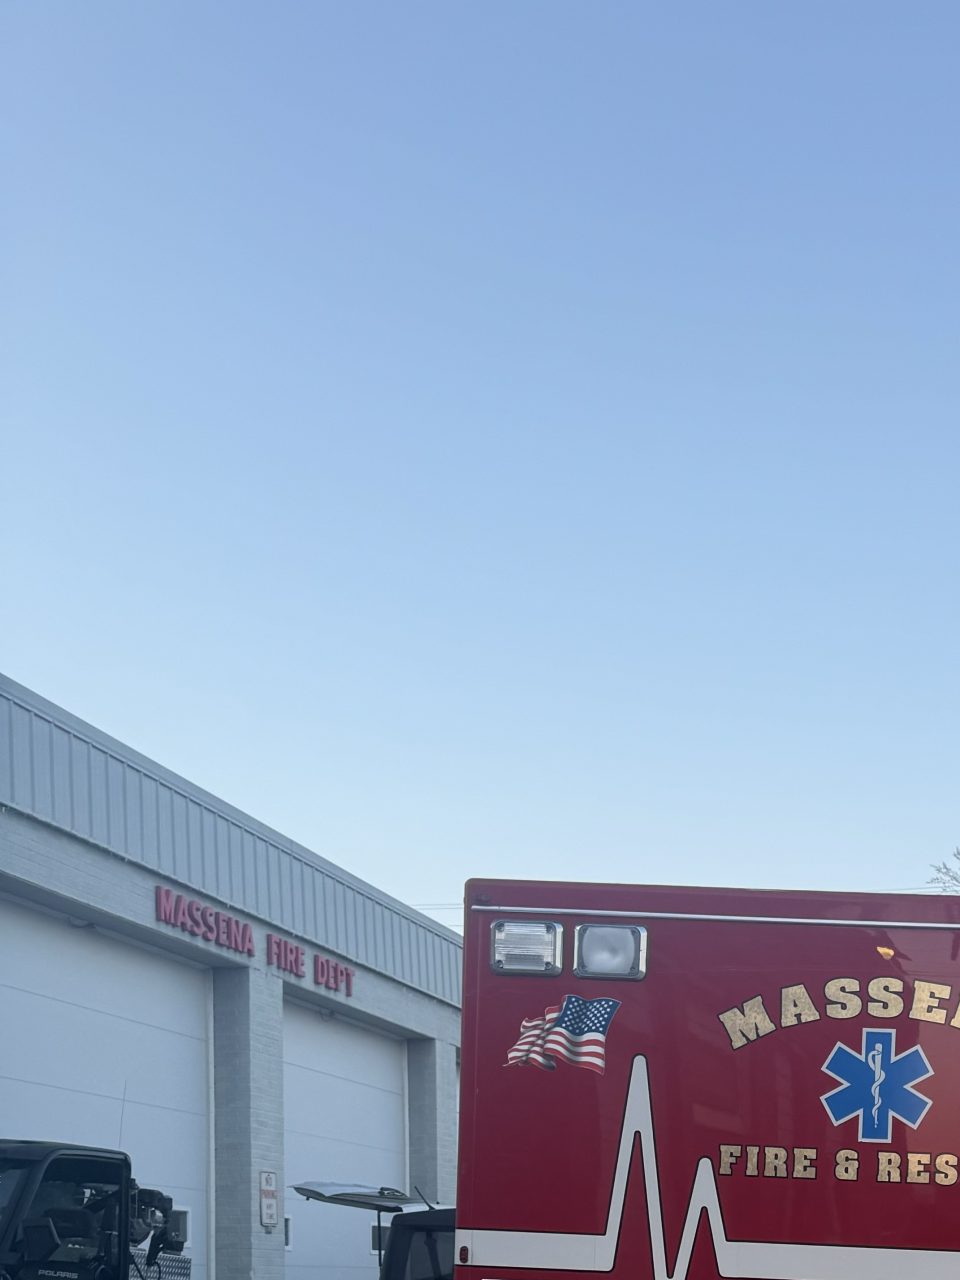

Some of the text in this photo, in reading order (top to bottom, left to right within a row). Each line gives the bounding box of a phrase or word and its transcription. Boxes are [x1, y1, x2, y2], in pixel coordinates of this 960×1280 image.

[155, 885, 355, 998] MASSENA FIRE DEPT
[718, 1144, 818, 1179] FIRE
[834, 1149, 860, 1182] &
[38, 1269, 79, 1279] POLARIS
